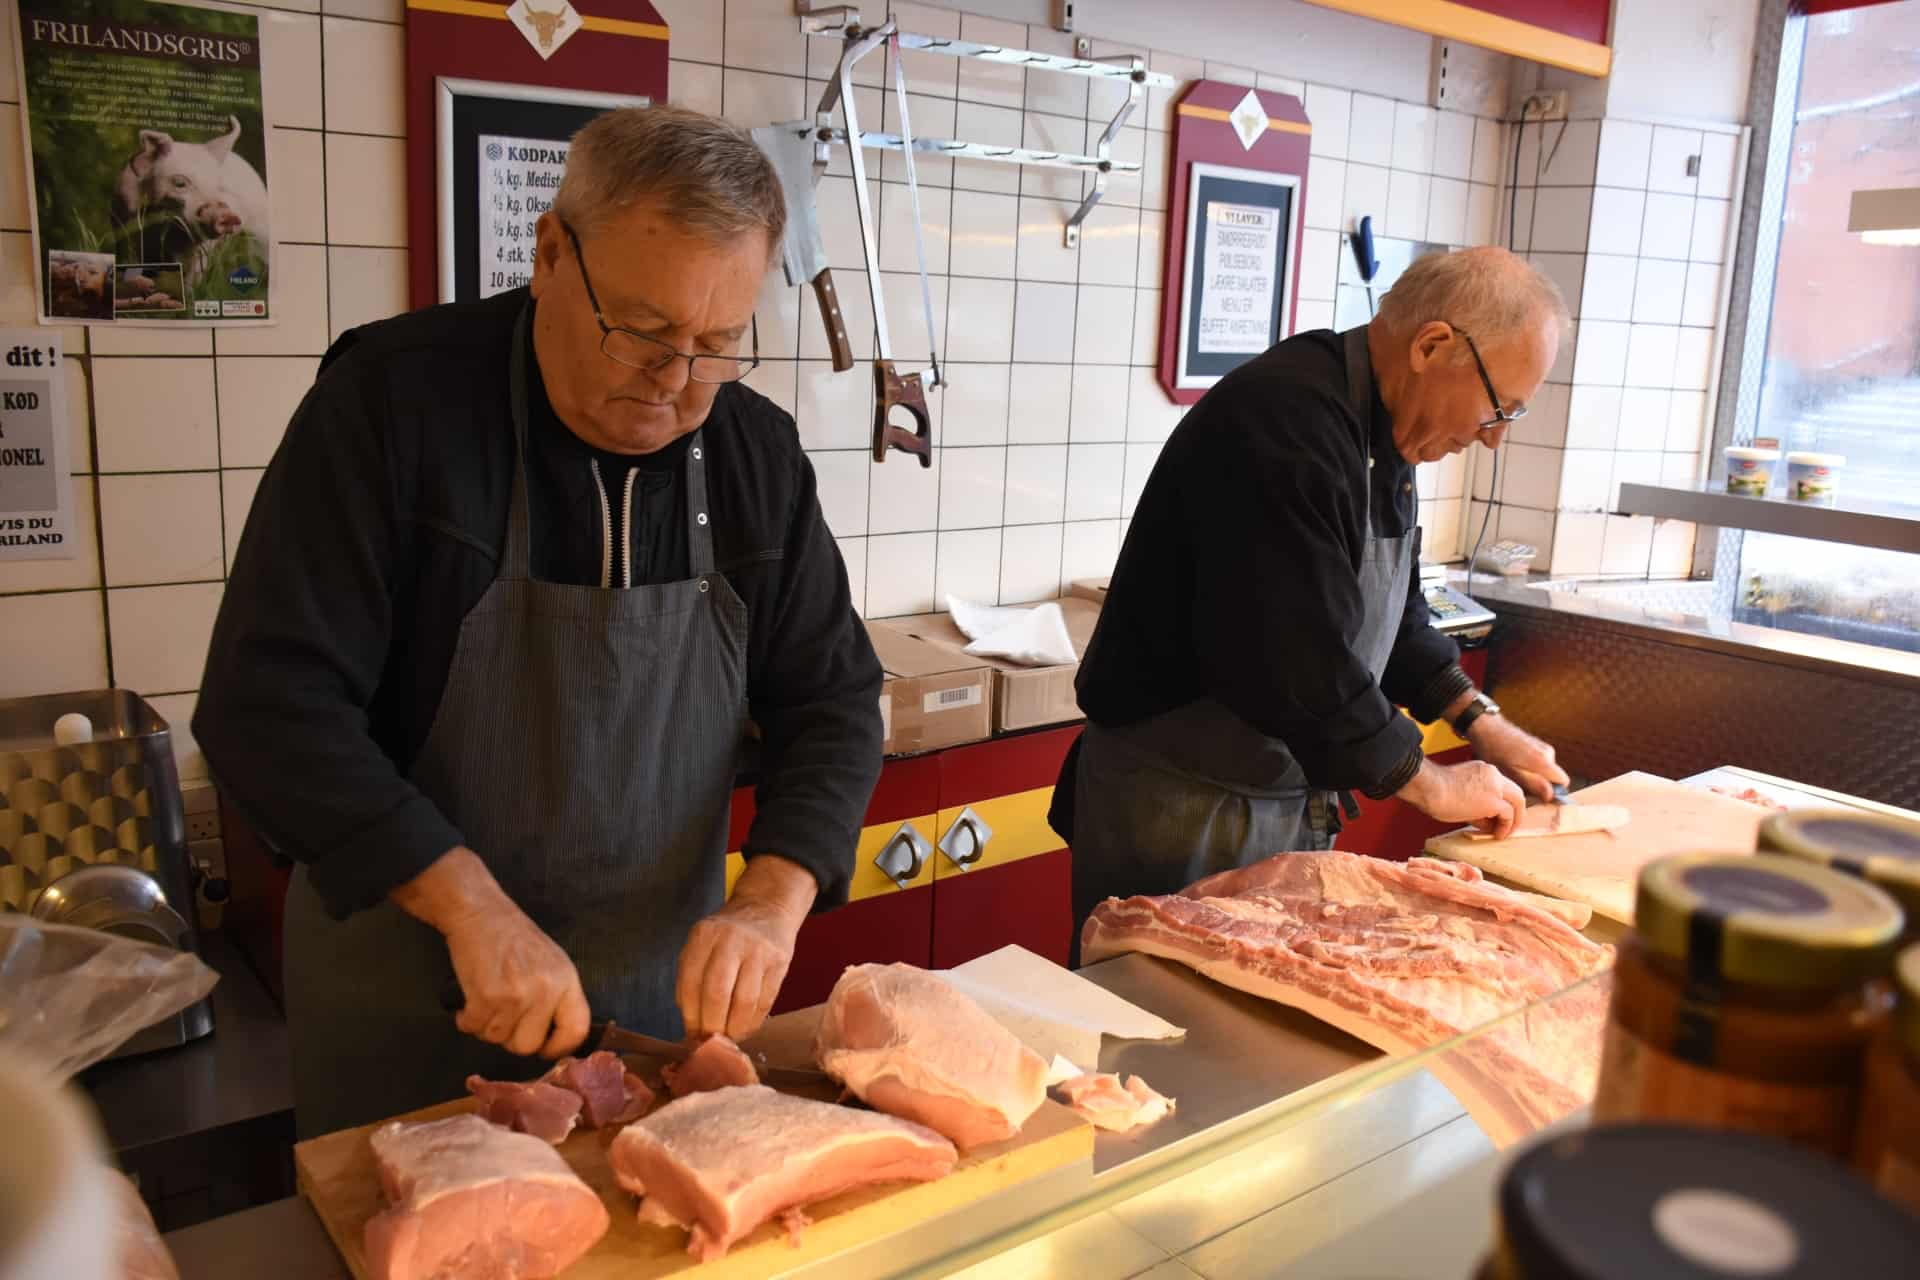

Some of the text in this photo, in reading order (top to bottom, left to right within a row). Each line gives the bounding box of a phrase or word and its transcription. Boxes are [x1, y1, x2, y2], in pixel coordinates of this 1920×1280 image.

[507, 169, 522, 190] kg.
[526, 171, 561, 188] Medist
[507, 195, 522, 216] kg.
[526, 196, 553, 212] Okse
[506, 220, 523, 242] kg.
[497, 247, 503, 262] 4
[507, 247, 526, 263] stk.
[491, 271, 504, 288] 10
[6, 346, 43, 367] dit
[3, 391, 39, 410] KØD
[29, 518, 53, 529] DU
